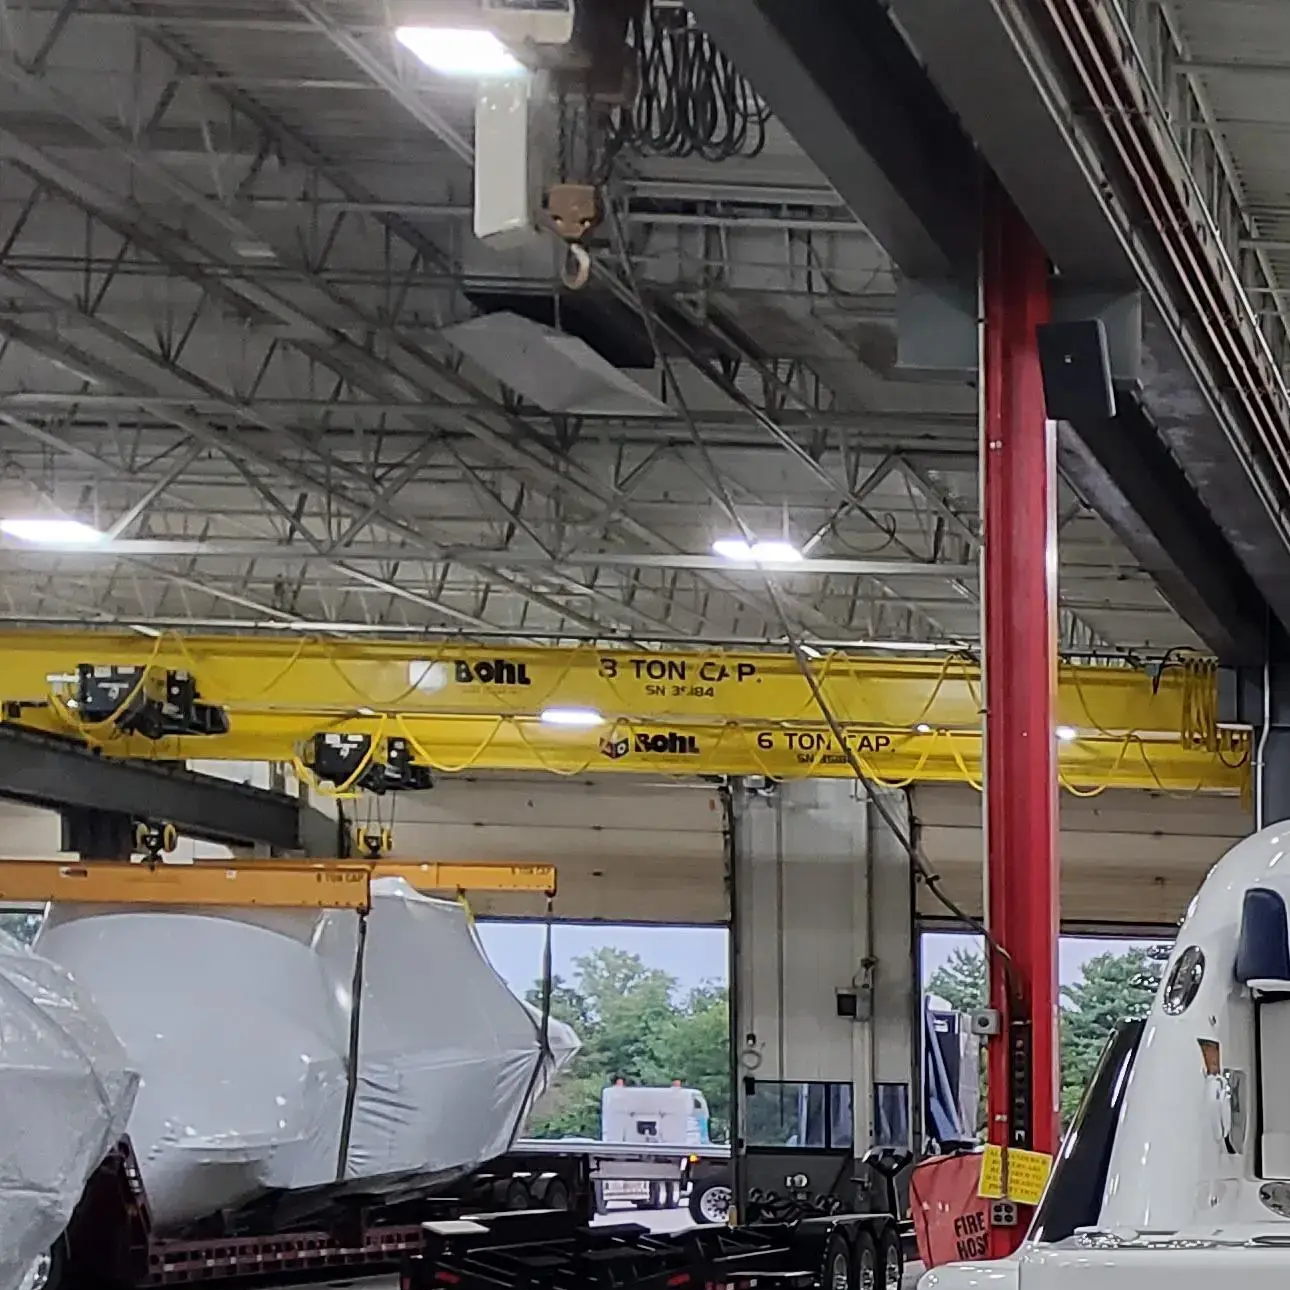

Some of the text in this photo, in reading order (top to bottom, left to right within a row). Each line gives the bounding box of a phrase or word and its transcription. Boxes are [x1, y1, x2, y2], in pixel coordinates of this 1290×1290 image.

[628, 658, 687, 680] TON
[699, 660, 763, 684] CAP.
[757, 731, 774, 749] 6
[783, 732, 832, 751] TON
[954, 1211, 985, 1237] FIRE
